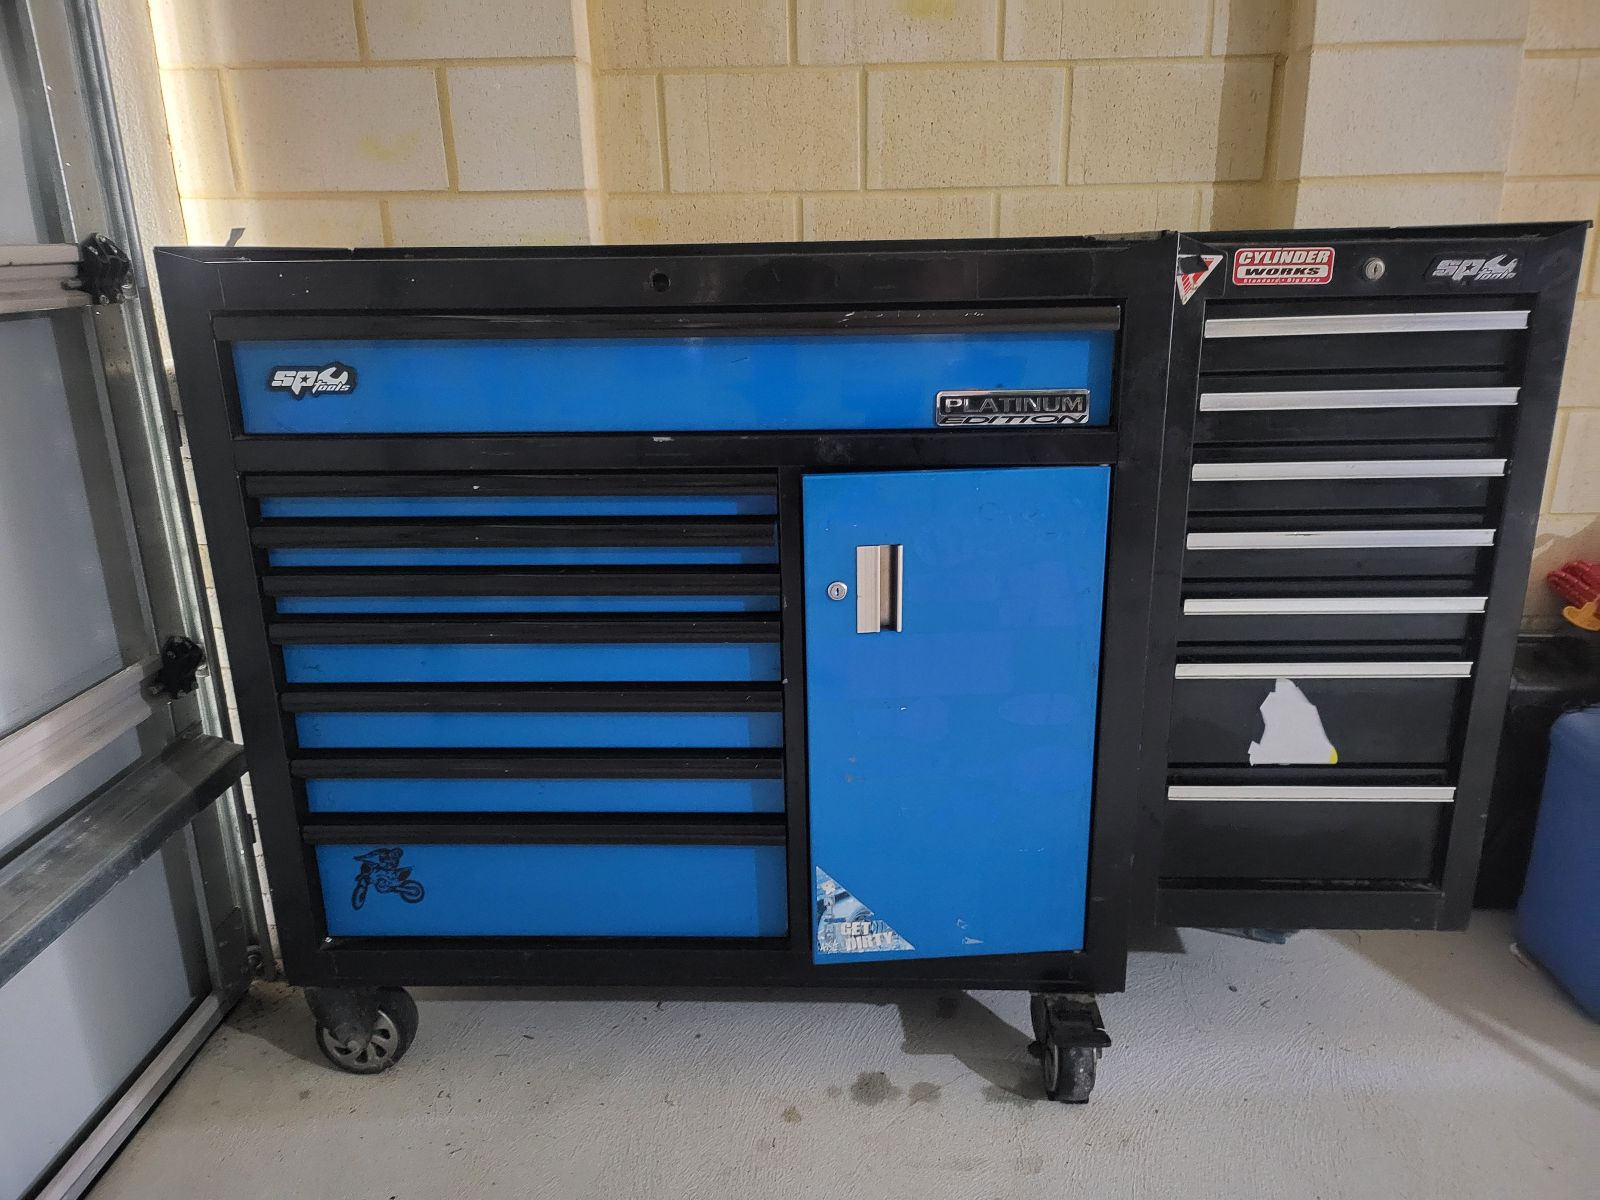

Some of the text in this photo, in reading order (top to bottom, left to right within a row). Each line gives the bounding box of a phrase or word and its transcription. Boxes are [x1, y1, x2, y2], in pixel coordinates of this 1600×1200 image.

[1239, 250, 1330, 264] CYLINDER
[1245, 267, 1320, 276] WORKS
[945, 396, 1084, 413] PLATINUM
[939, 414, 1087, 425] EDITION
[841, 921, 871, 936] GET
[845, 931, 893, 951] DIRTY
